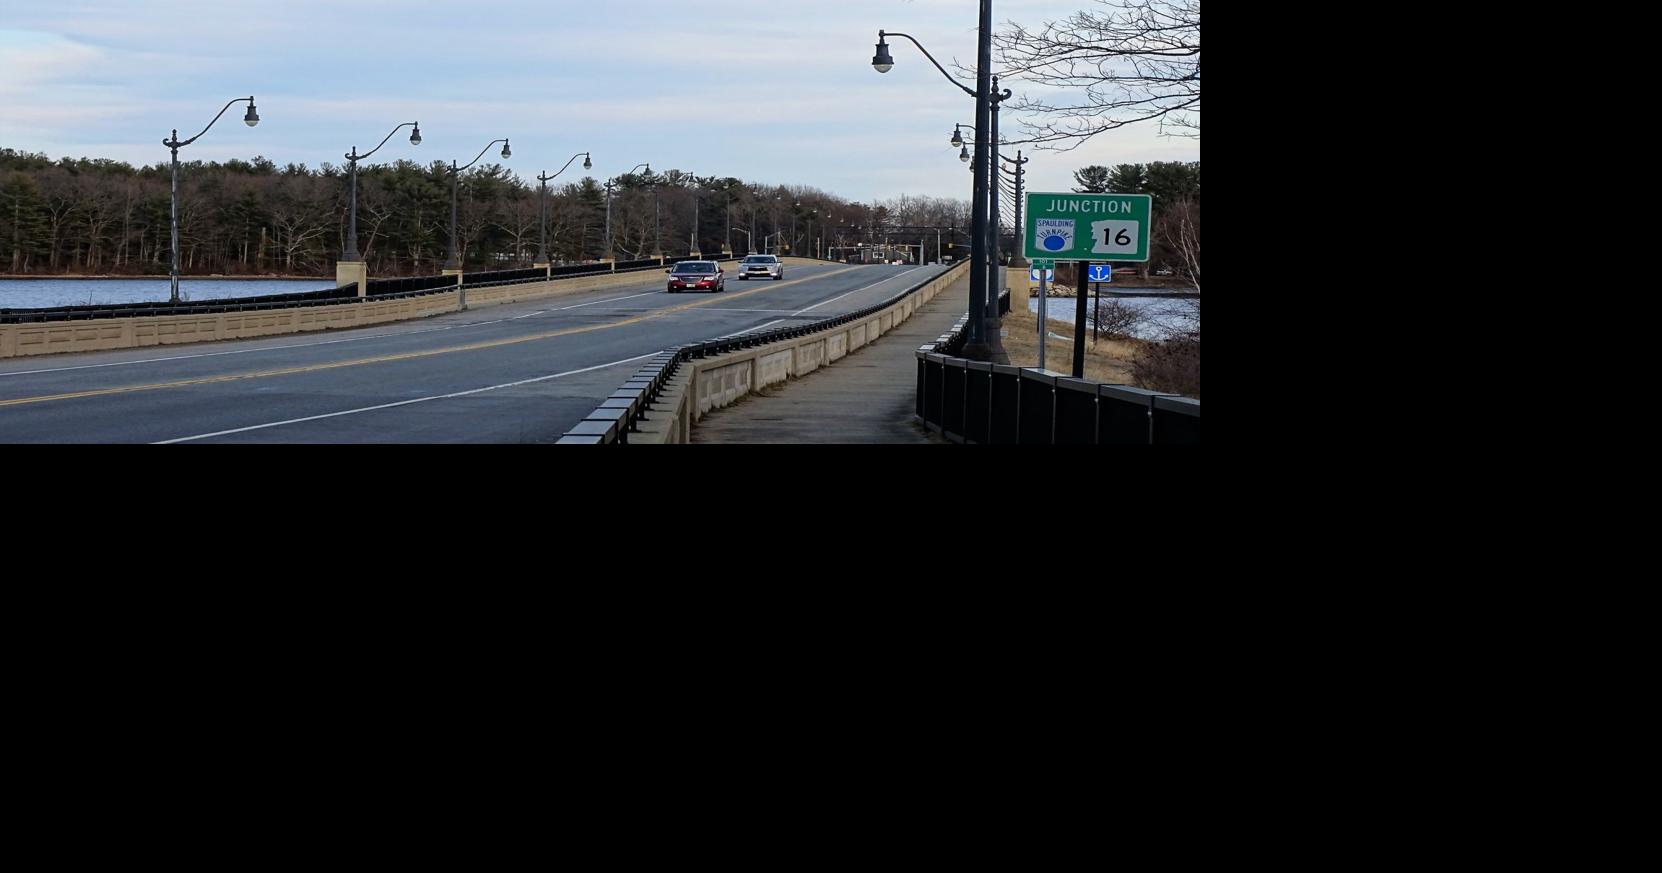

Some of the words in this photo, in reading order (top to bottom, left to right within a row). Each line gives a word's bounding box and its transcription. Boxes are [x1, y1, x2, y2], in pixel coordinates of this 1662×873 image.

[1046, 200, 1131, 213] JUNCTION
[1037, 229, 1072, 240] TURNPIKE
[1104, 228, 1131, 246] 16
